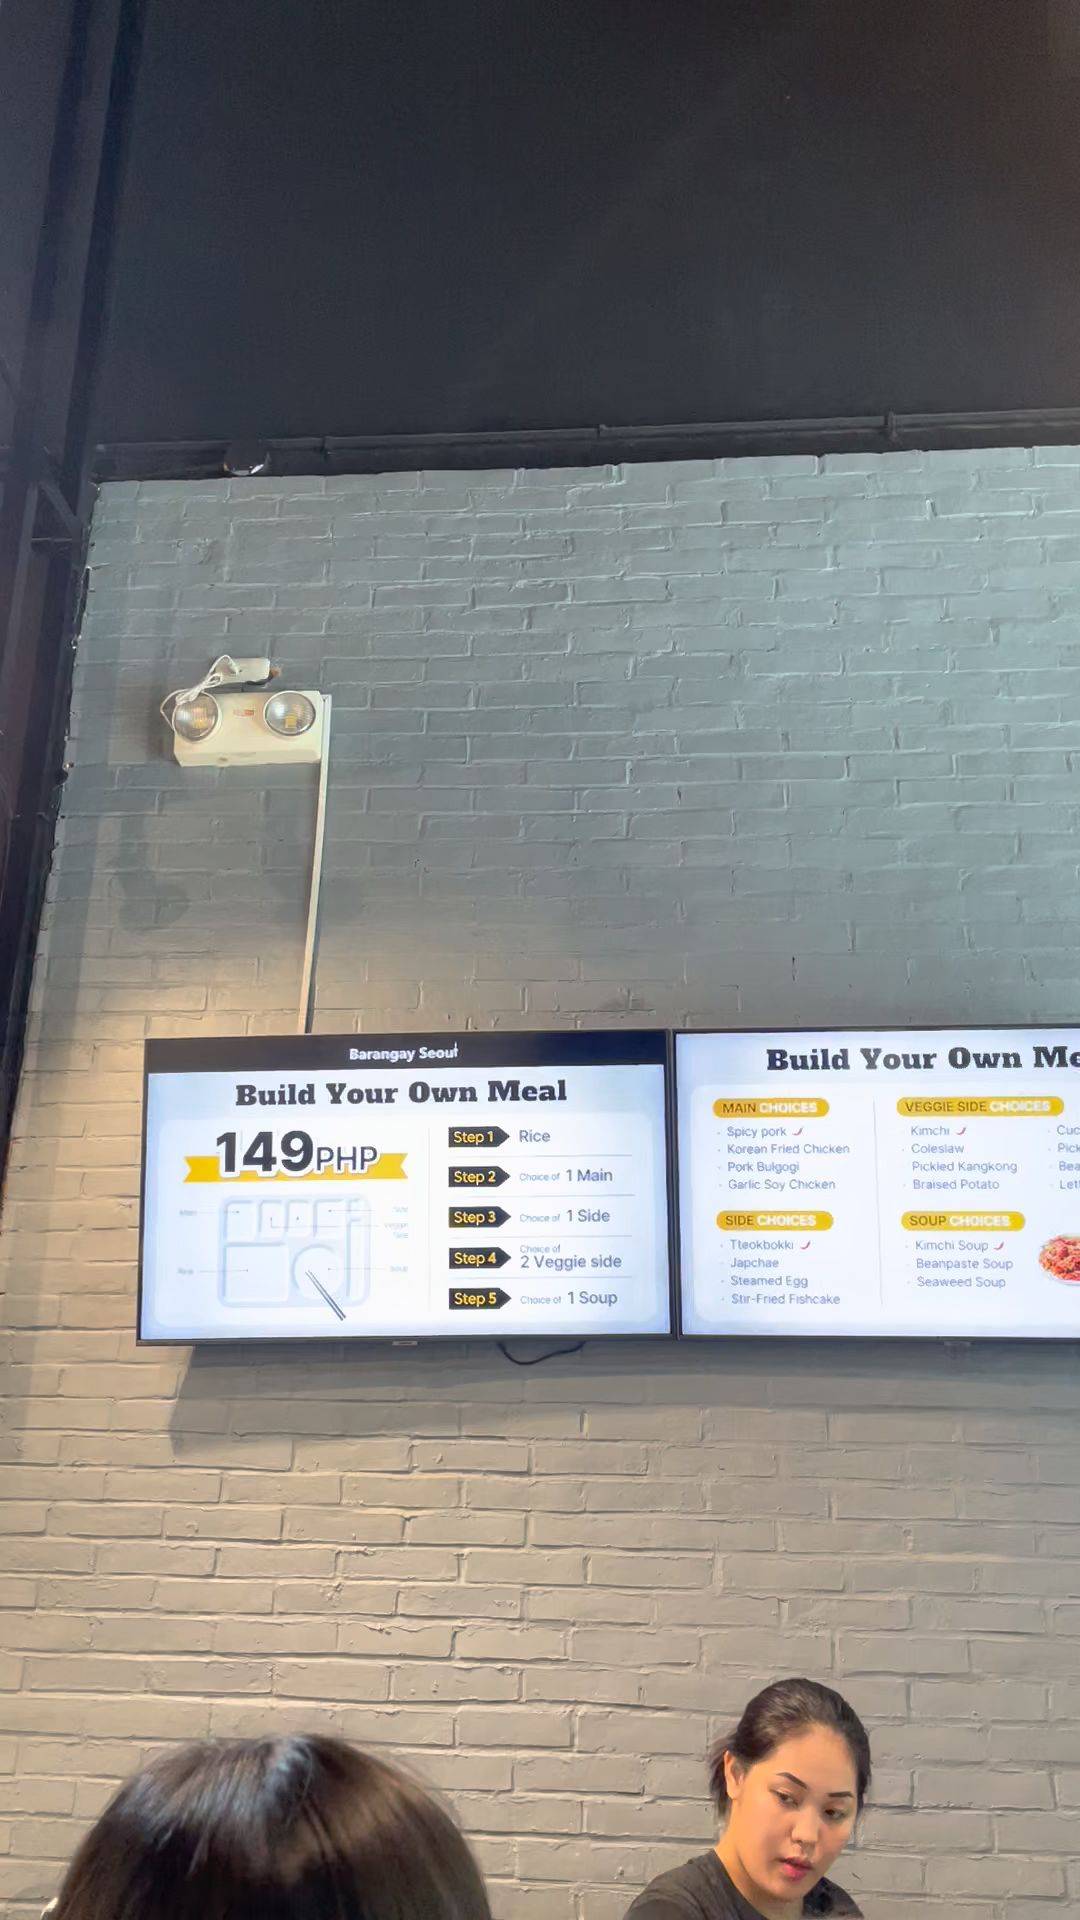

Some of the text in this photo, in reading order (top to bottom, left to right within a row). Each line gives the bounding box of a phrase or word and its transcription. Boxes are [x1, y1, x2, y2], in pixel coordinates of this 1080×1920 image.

[349, 1041, 458, 1062] Barangay Seoul
[767, 1049, 850, 1070] Build
[860, 1048, 937, 1069] Your
[948, 1047, 1022, 1069] Own
[236, 1080, 567, 1106] Build Your Own Meal
[723, 1102, 817, 1113] MAIN CHOICES
[905, 1101, 1050, 1112] VEGGIE SIDE CHOICES
[519, 1130, 550, 1142] Rice
[727, 1126, 786, 1138] Spicy pork
[911, 1126, 950, 1136] Kimchi
[453, 1131, 494, 1145] Step 1
[216, 1131, 377, 1172] 149 PHP
[727, 1143, 850, 1154] Korean Fried Chicken
[911, 1144, 964, 1153] Coleslaw
[727, 1161, 800, 1173] Pork Bulgogi
[912, 1161, 1018, 1174] Pickled Kangkong
[454, 1171, 496, 1186] Step 2
[519, 1169, 613, 1182] Choice of 1 Main
[728, 1179, 836, 1191] Garlic Soy Chicken
[913, 1179, 1000, 1189] Braised Potato
[454, 1211, 496, 1226] Step 3
[520, 1209, 610, 1222] Choice of 1 Side
[725, 1215, 816, 1226] SIDE CHOICES
[909, 1215, 1011, 1226] SOUP CHOICES
[520, 1244, 561, 1254] Choice of
[730, 1239, 794, 1250] Tteokbokki
[915, 1240, 989, 1253] Kimchi Soup
[454, 1252, 496, 1267] Step 4
[520, 1254, 622, 1271] 2 Veggie side
[730, 1257, 779, 1269] Japchae
[916, 1258, 1014, 1271] Beanpaste Soup
[730, 1275, 808, 1288] Steamed Egg
[917, 1276, 1006, 1288] Seaweed Soup
[454, 1293, 496, 1308] Step 5
[520, 1291, 618, 1307] Choice of 1 Soup
[731, 1293, 841, 1304] Stir-Fried Fishcake
